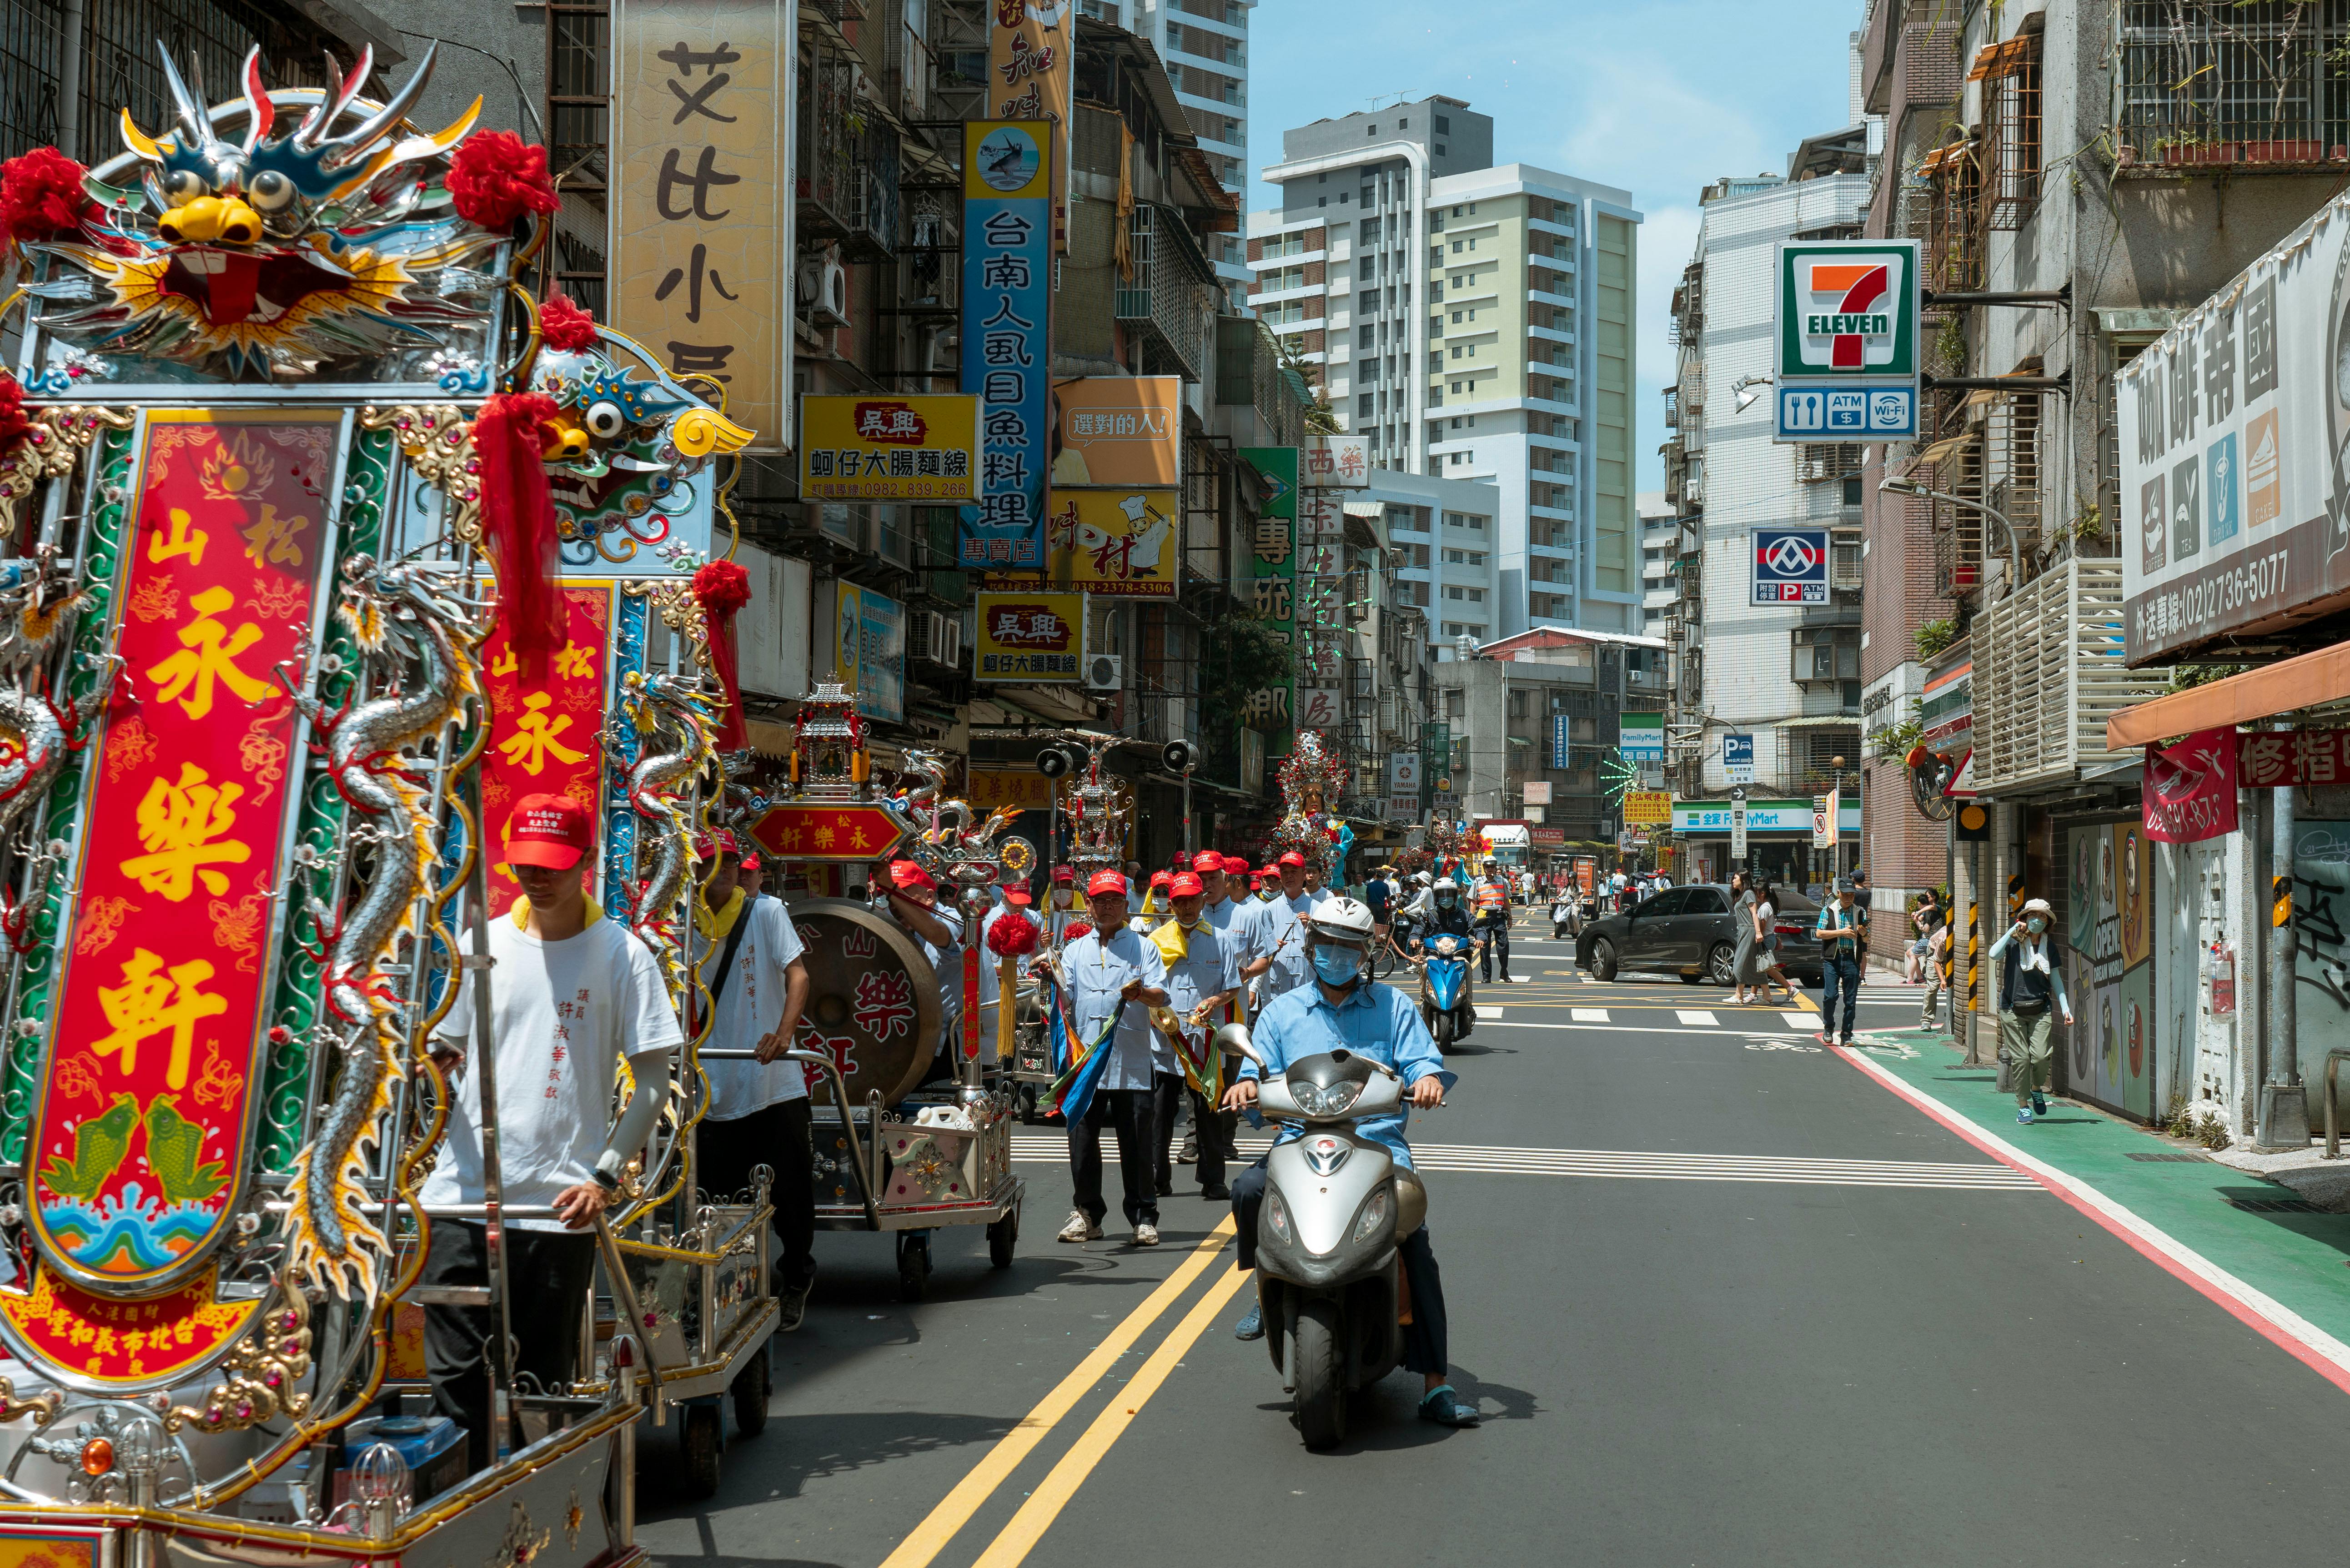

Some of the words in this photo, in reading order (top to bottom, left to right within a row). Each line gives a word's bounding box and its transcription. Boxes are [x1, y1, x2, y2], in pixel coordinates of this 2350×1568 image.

[980, 211, 1032, 526] 台南人虱目魚料理
[1833, 396, 1861, 406] ATM
[1875, 406, 1905, 415] Wi-Fi
[859, 410, 919, 438] 吳興
[1074, 413, 1166, 435] 選對的人!
[811, 450, 968, 477] 蚵仔大腸麵線
[1308, 444, 1365, 478] 西藥
[2255, 503, 2273, 523] CAKE
[148, 503, 310, 568] 松山
[2213, 523, 2234, 543] DRINK
[964, 538, 1036, 562] 專賣店
[2181, 539, 2192, 552] TEA
[2145, 556, 2164, 573] COFFEE
[1783, 585, 1797, 599] P
[993, 613, 1061, 643] 吳興
[984, 655, 1077, 672] 蚵仔大腸麵線
[499, 691, 589, 776] 永
[1622, 734, 1662, 742] FamilyMart
[1725, 739, 1738, 757] P
[2240, 734, 2350, 784] 修指
[1392, 798, 1417, 810] 機車修理
[801, 814, 851, 828] 松山
[1703, 813, 1720, 825] 全家
[779, 825, 871, 850] 永樂軒
[2096, 918, 2120, 959] OPEN!
[2094, 963, 2107, 983] DREAM
[2108, 958, 2123, 978] WORLD
[576, 989, 590, 1020] 議員
